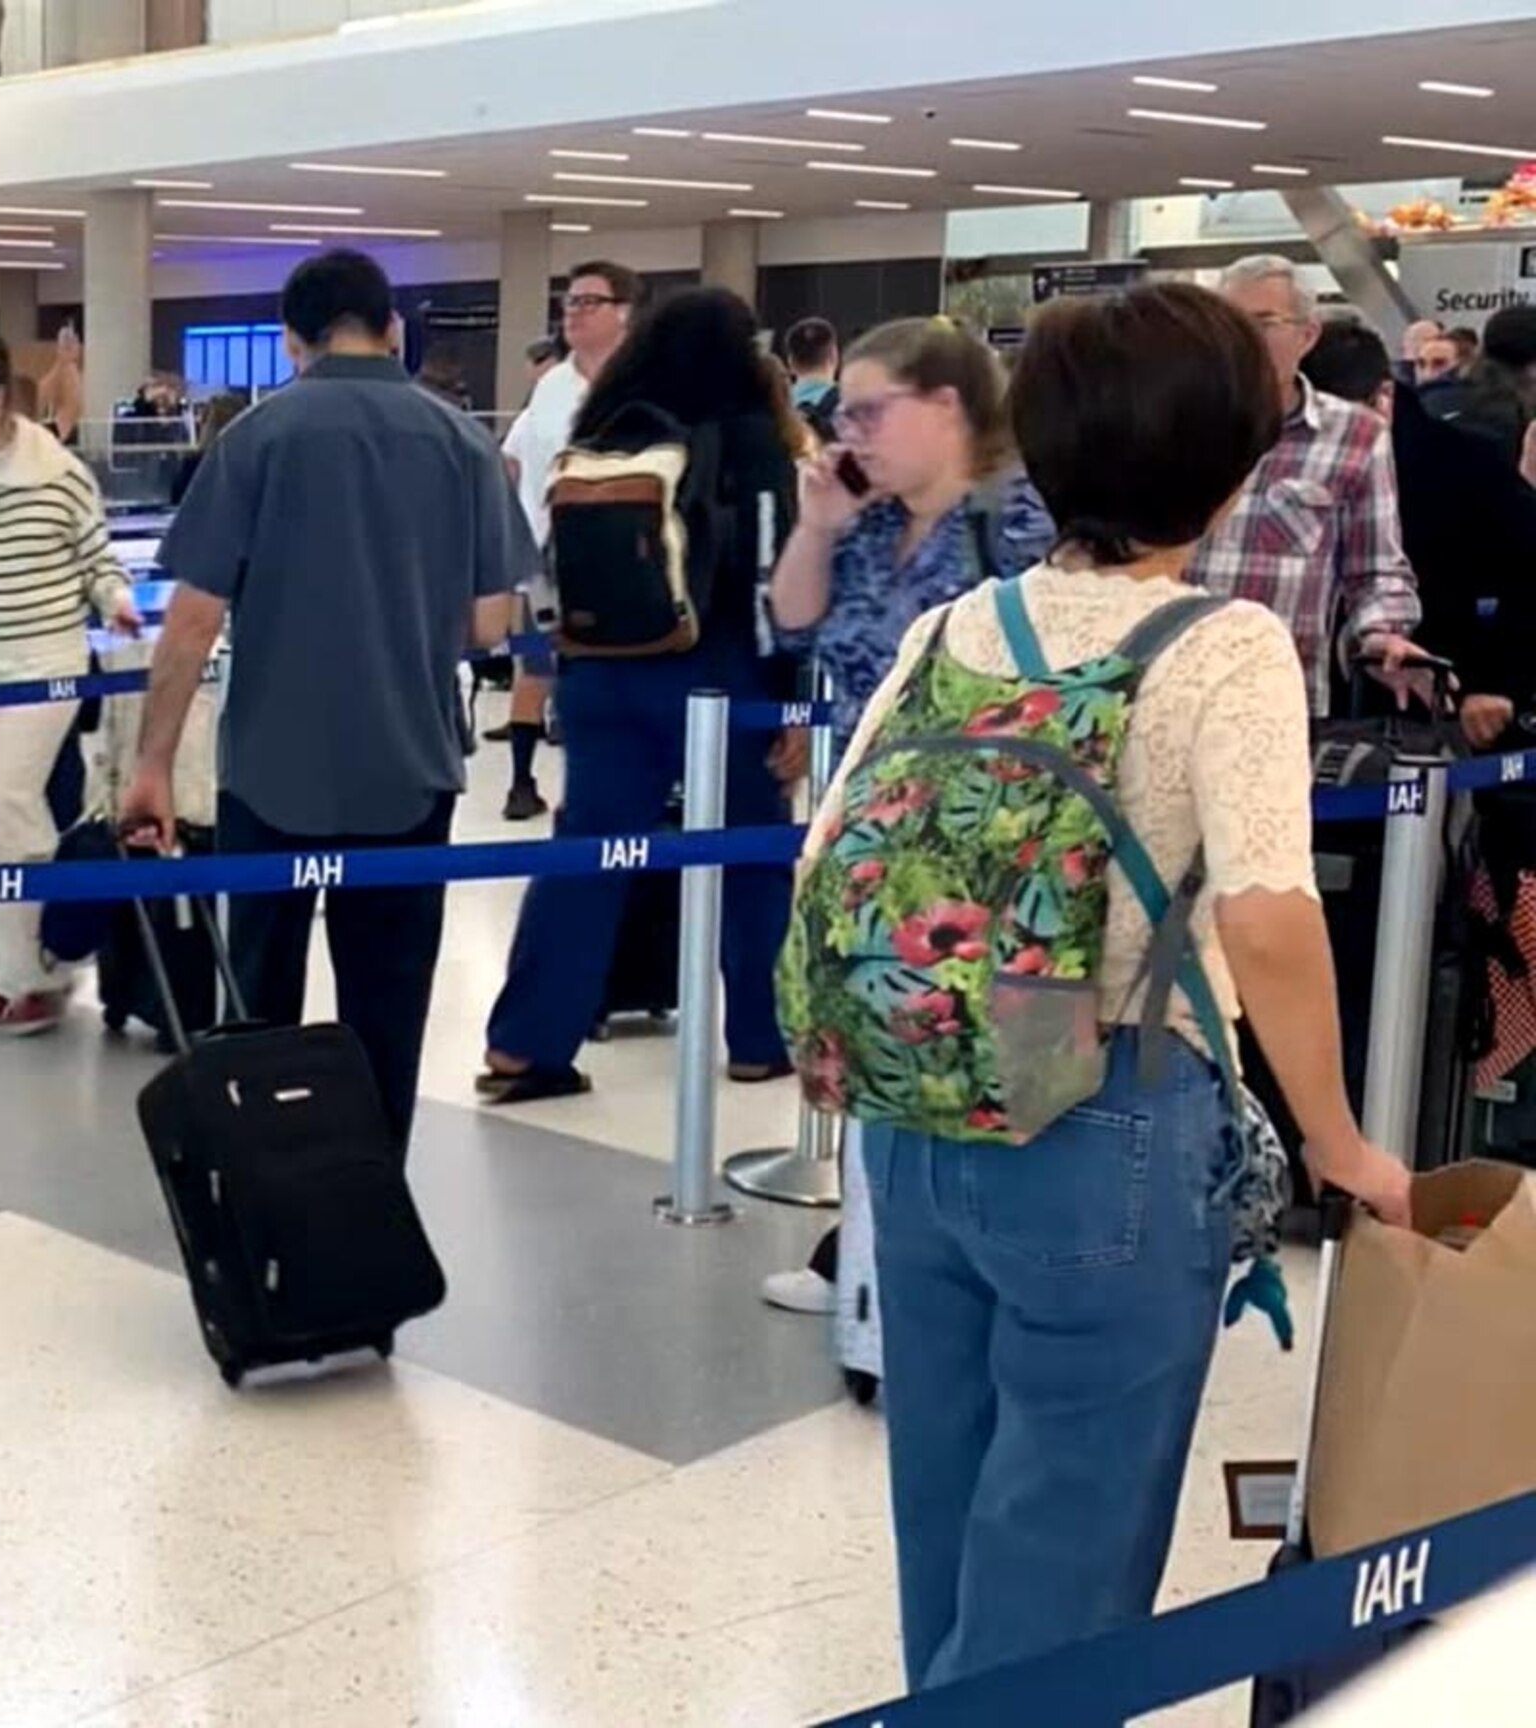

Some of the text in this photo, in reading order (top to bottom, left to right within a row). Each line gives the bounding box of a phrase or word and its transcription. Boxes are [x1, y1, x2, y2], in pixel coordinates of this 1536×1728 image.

[48, 680, 77, 698] IAH
[781, 702, 812, 726] IAH
[1500, 753, 1525, 782] IAH
[1387, 783, 1424, 812] IAH
[601, 837, 649, 870] IAH
[292, 853, 343, 889] IAH
[1351, 1538, 1431, 1628] IAH
